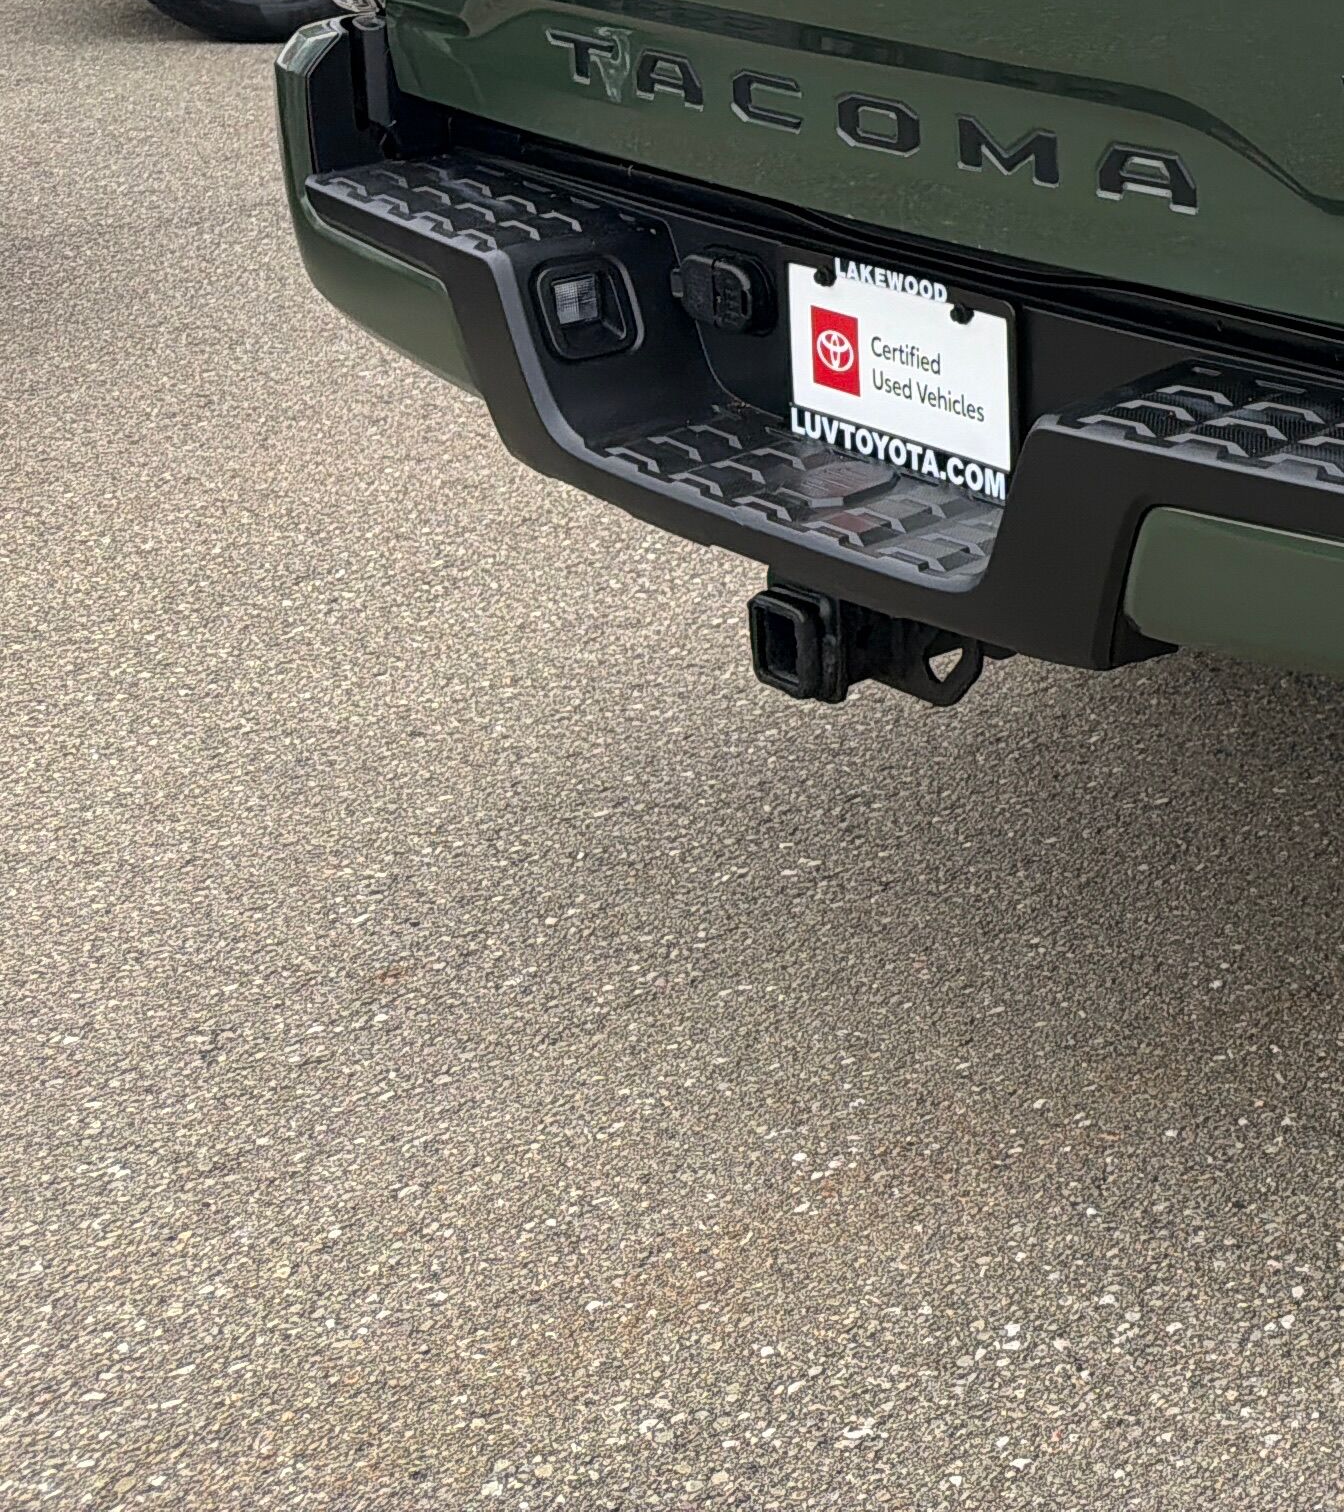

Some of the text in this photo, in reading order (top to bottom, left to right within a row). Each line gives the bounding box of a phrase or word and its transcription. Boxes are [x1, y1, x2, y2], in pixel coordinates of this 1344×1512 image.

[545, 27, 1199, 215] TACOMA
[834, 257, 948, 304] LAKEWOOD
[870, 336, 941, 376] Certified
[872, 368, 985, 423] Used Vehicles
[790, 407, 1007, 501] LUVTOYOTA.COM
